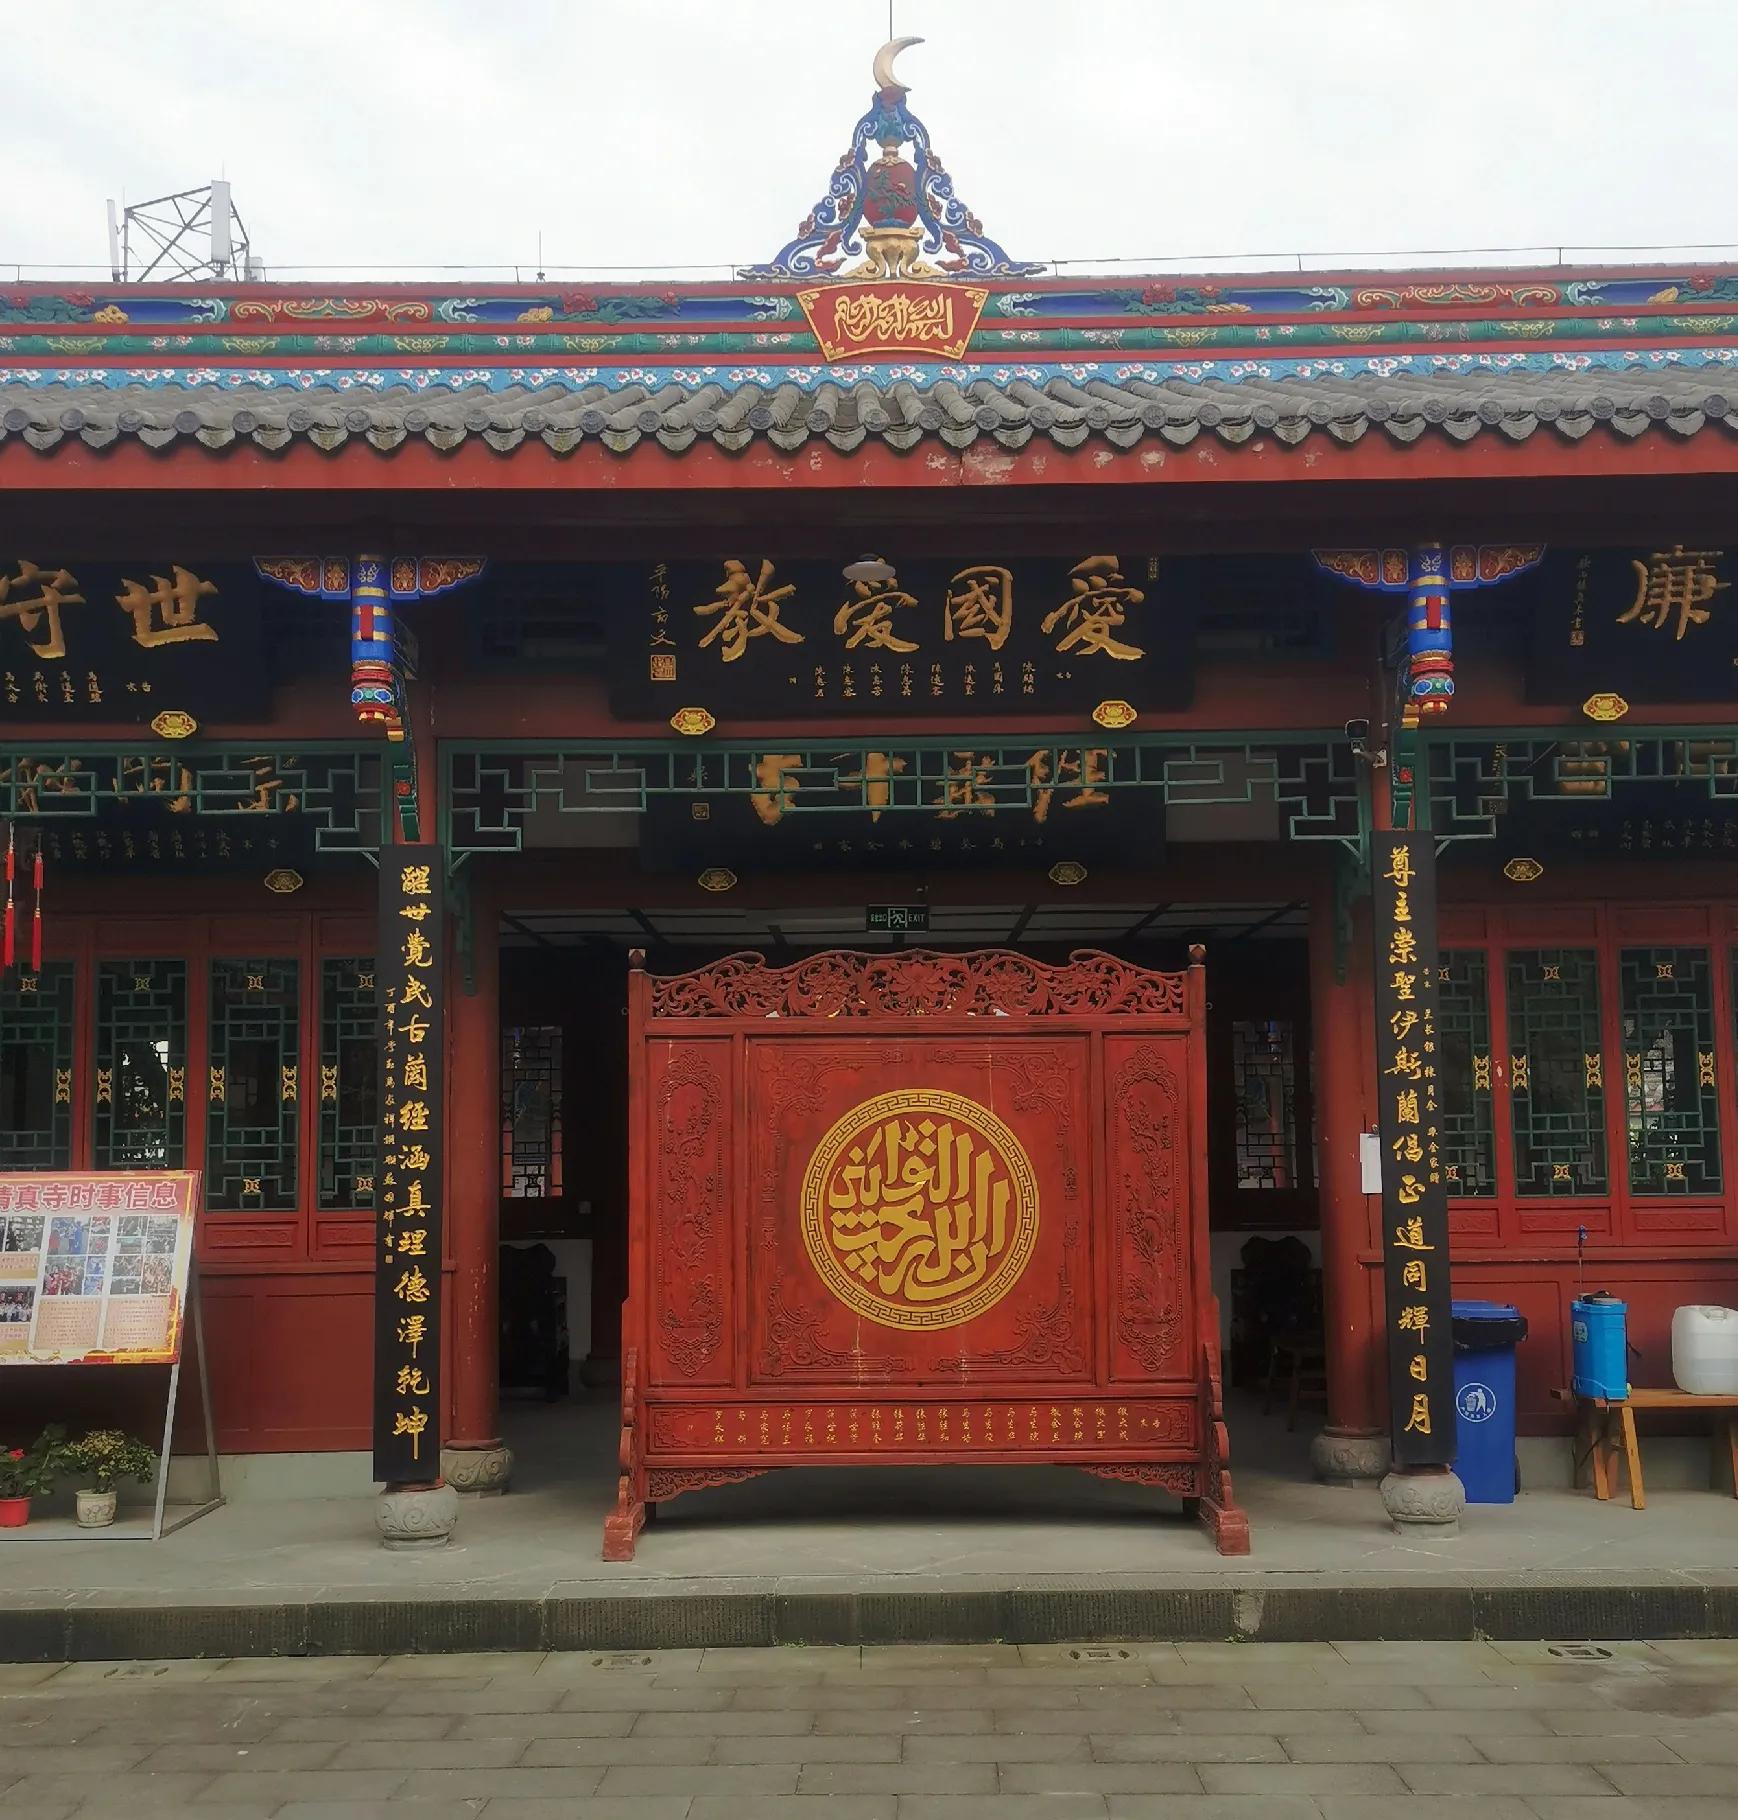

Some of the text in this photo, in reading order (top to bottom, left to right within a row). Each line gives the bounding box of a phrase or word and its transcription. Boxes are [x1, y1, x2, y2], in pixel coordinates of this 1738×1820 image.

[692, 553, 1146, 662] 愛國愛教
[908, 913, 925, 922] EXIT
